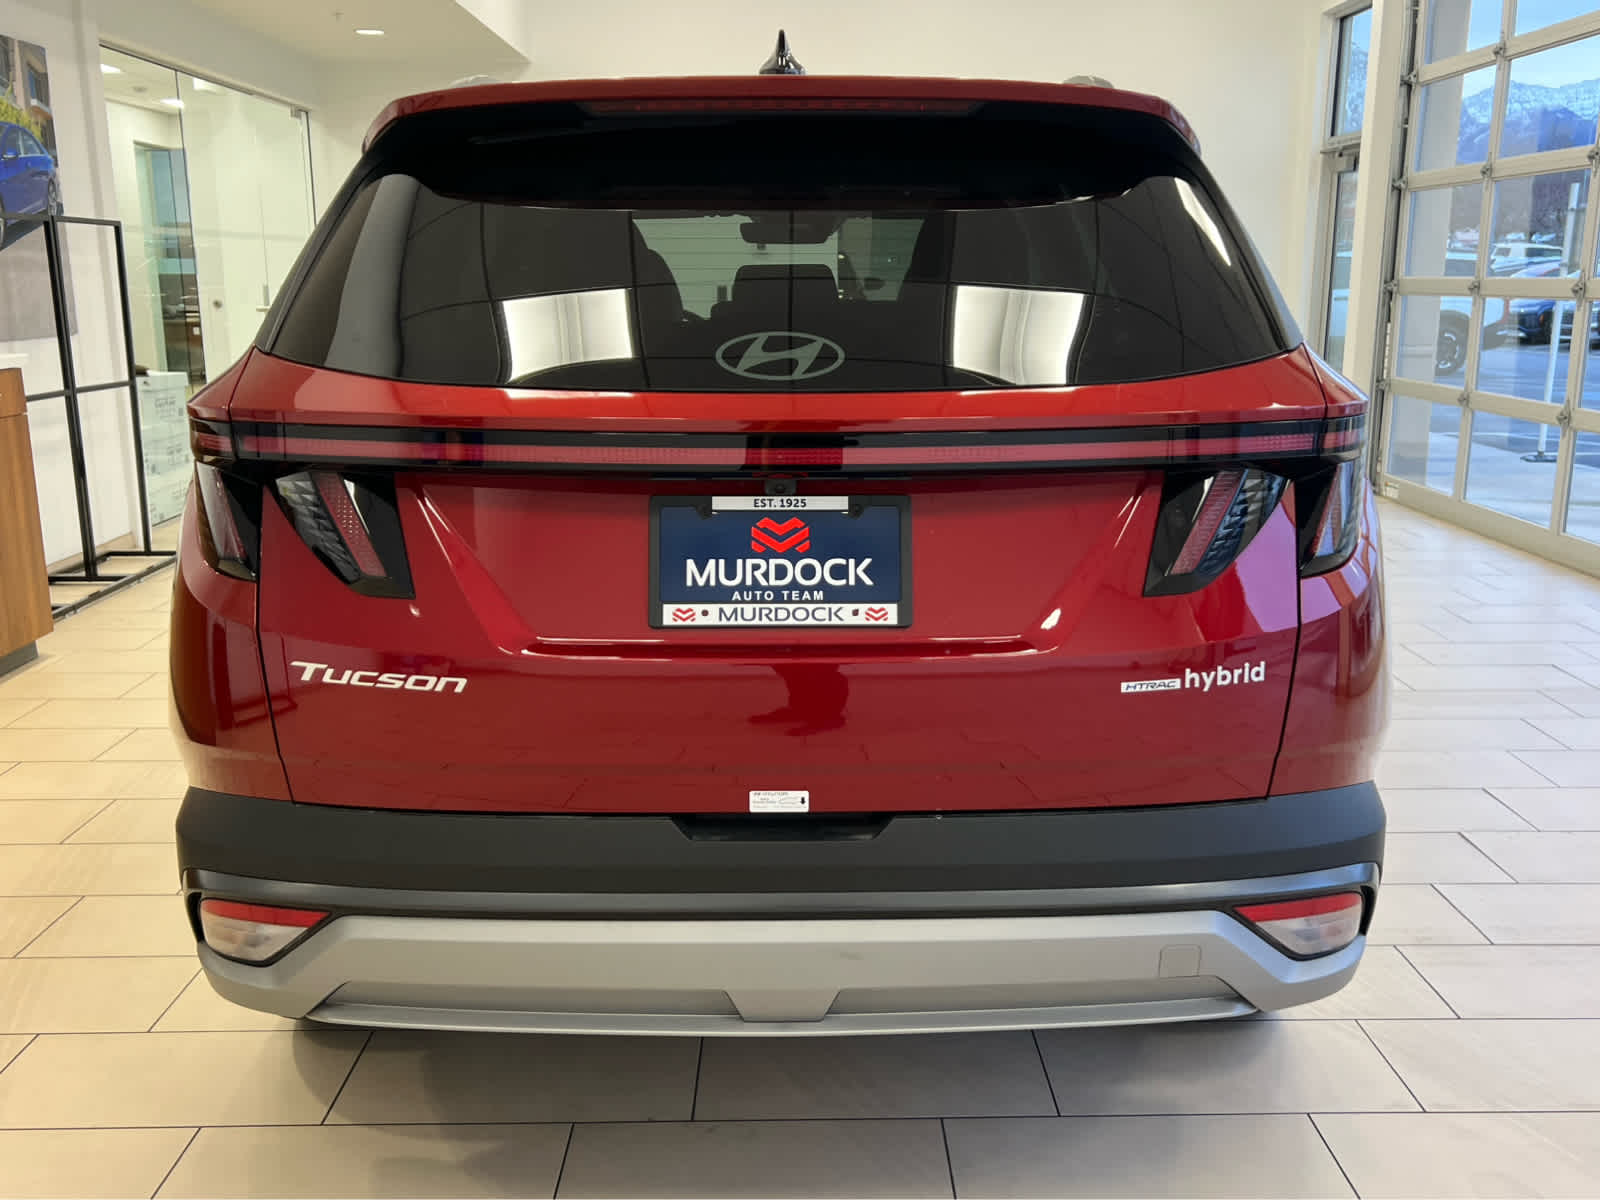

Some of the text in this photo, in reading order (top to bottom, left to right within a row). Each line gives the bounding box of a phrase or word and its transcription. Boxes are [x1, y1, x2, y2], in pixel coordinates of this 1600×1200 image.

[753, 498, 807, 508] EST. 1925
[685, 557, 874, 587] MURDOCK
[731, 591, 824, 601] AUTO TEAM
[718, 606, 845, 622] MURDOCK
[1125, 660, 1266, 692] HTRAC hybrid
